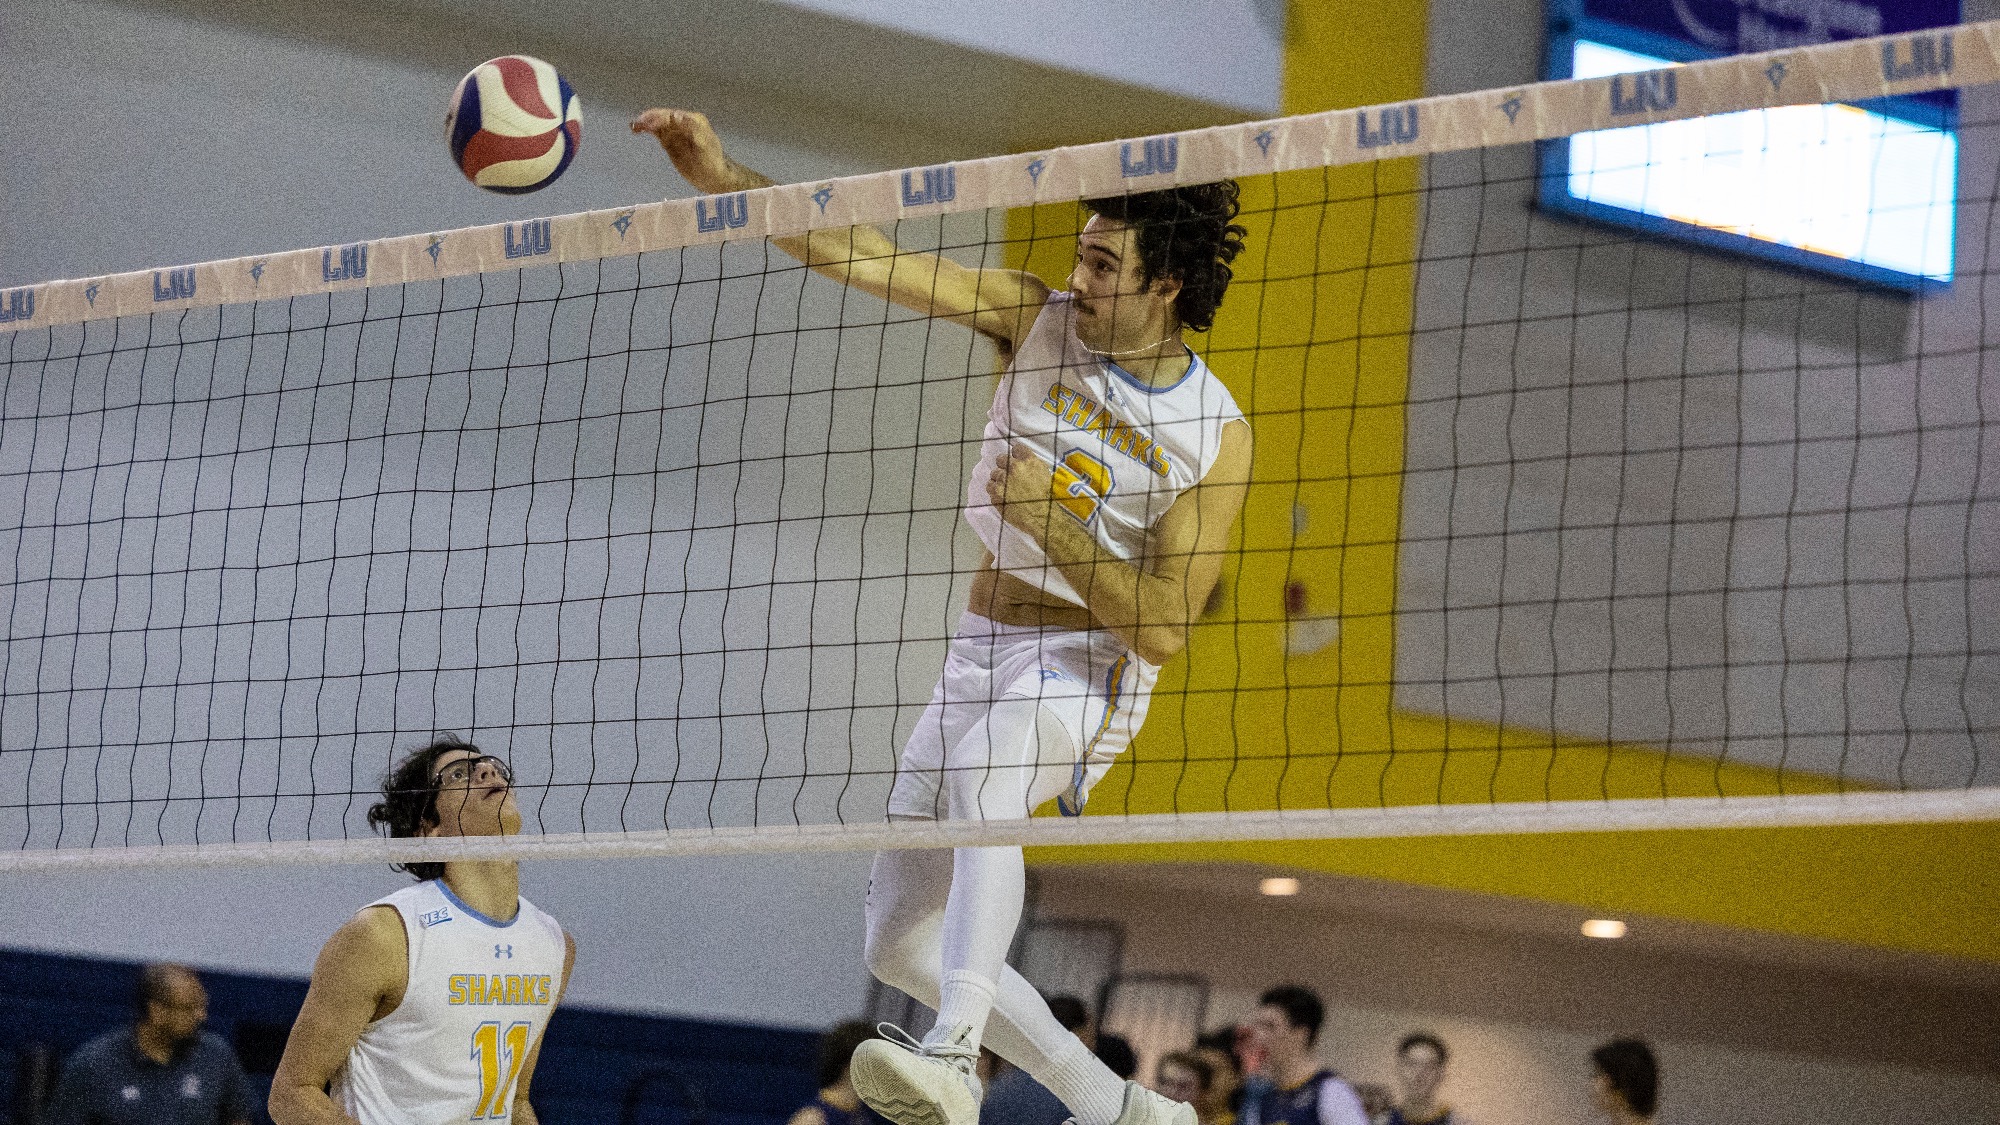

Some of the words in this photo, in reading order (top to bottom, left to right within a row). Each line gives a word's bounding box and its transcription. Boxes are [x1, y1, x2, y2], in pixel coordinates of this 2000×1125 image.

[1882, 33, 1954, 82] LIU
[1610, 69, 1677, 115] LIU
[1356, 105, 1420, 149] LIU
[1120, 137, 1178, 178] LIU
[901, 166, 956, 208] LIU
[696, 192, 749, 234] LIU
[504, 219, 552, 259] LIU
[322, 243, 367, 282] LIU
[153, 267, 196, 302] LIU
[1040, 382, 1173, 478] SHARKS
[1052, 446, 1116, 528] 2
[448, 974, 551, 1006] SHARKS
[470, 1021, 531, 1120] 11
